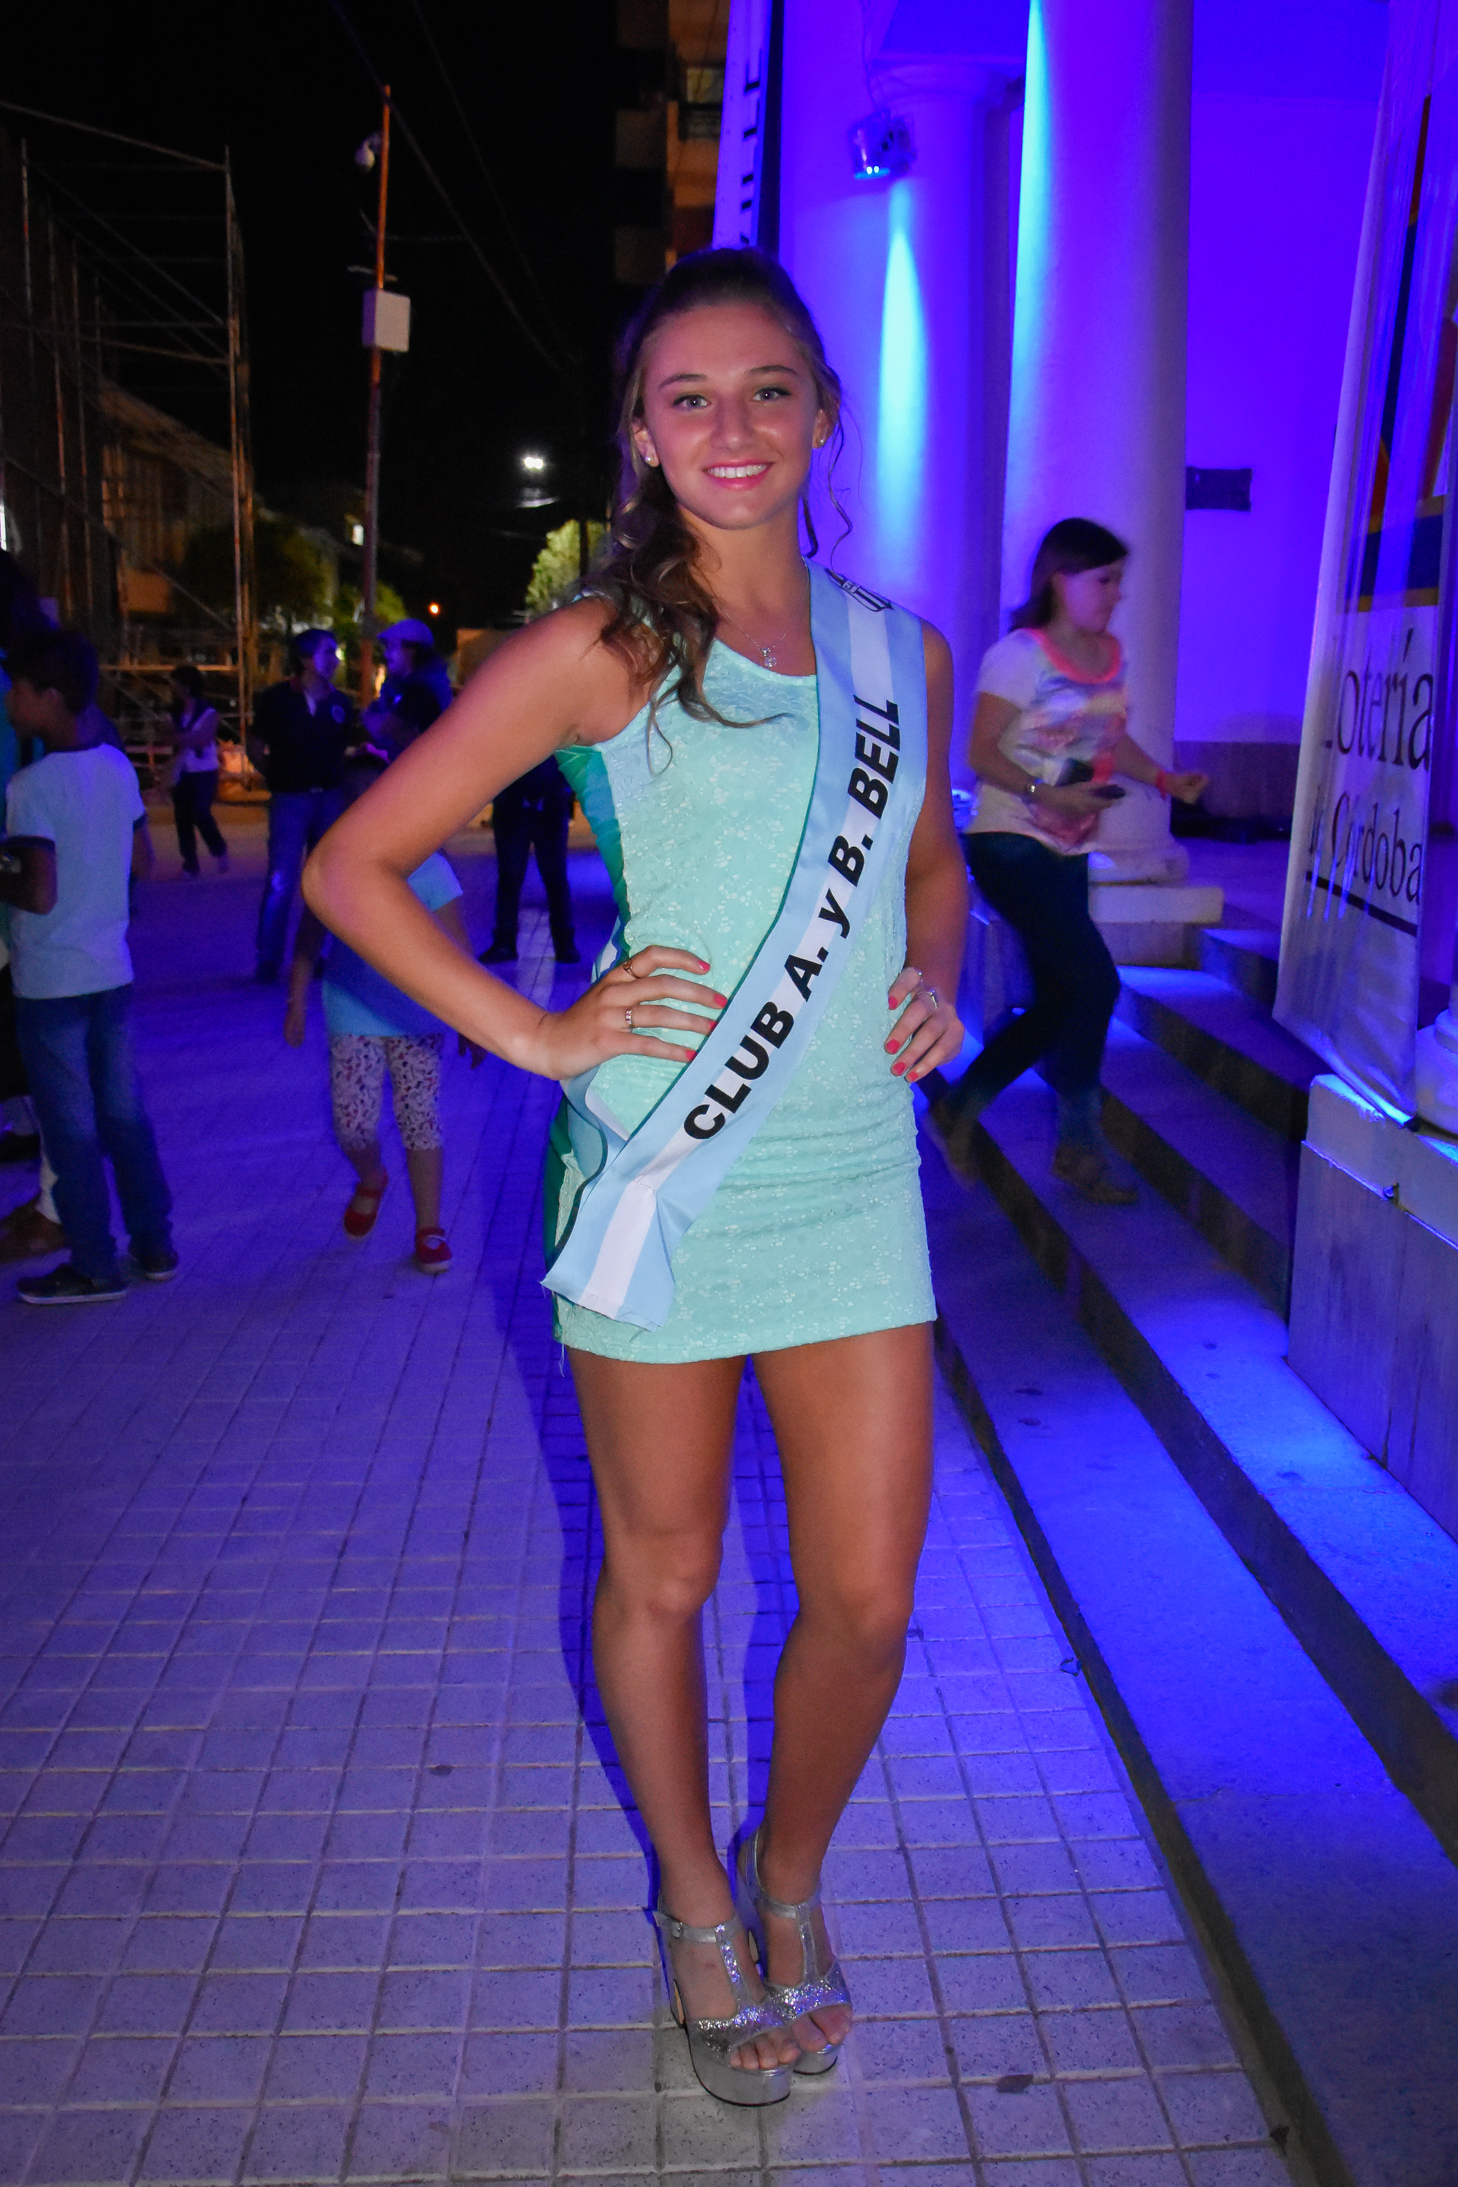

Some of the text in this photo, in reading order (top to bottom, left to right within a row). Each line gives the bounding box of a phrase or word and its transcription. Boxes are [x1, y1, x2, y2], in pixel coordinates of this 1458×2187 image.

[684, 695, 901, 1140] CLUB A. y B. BELL
